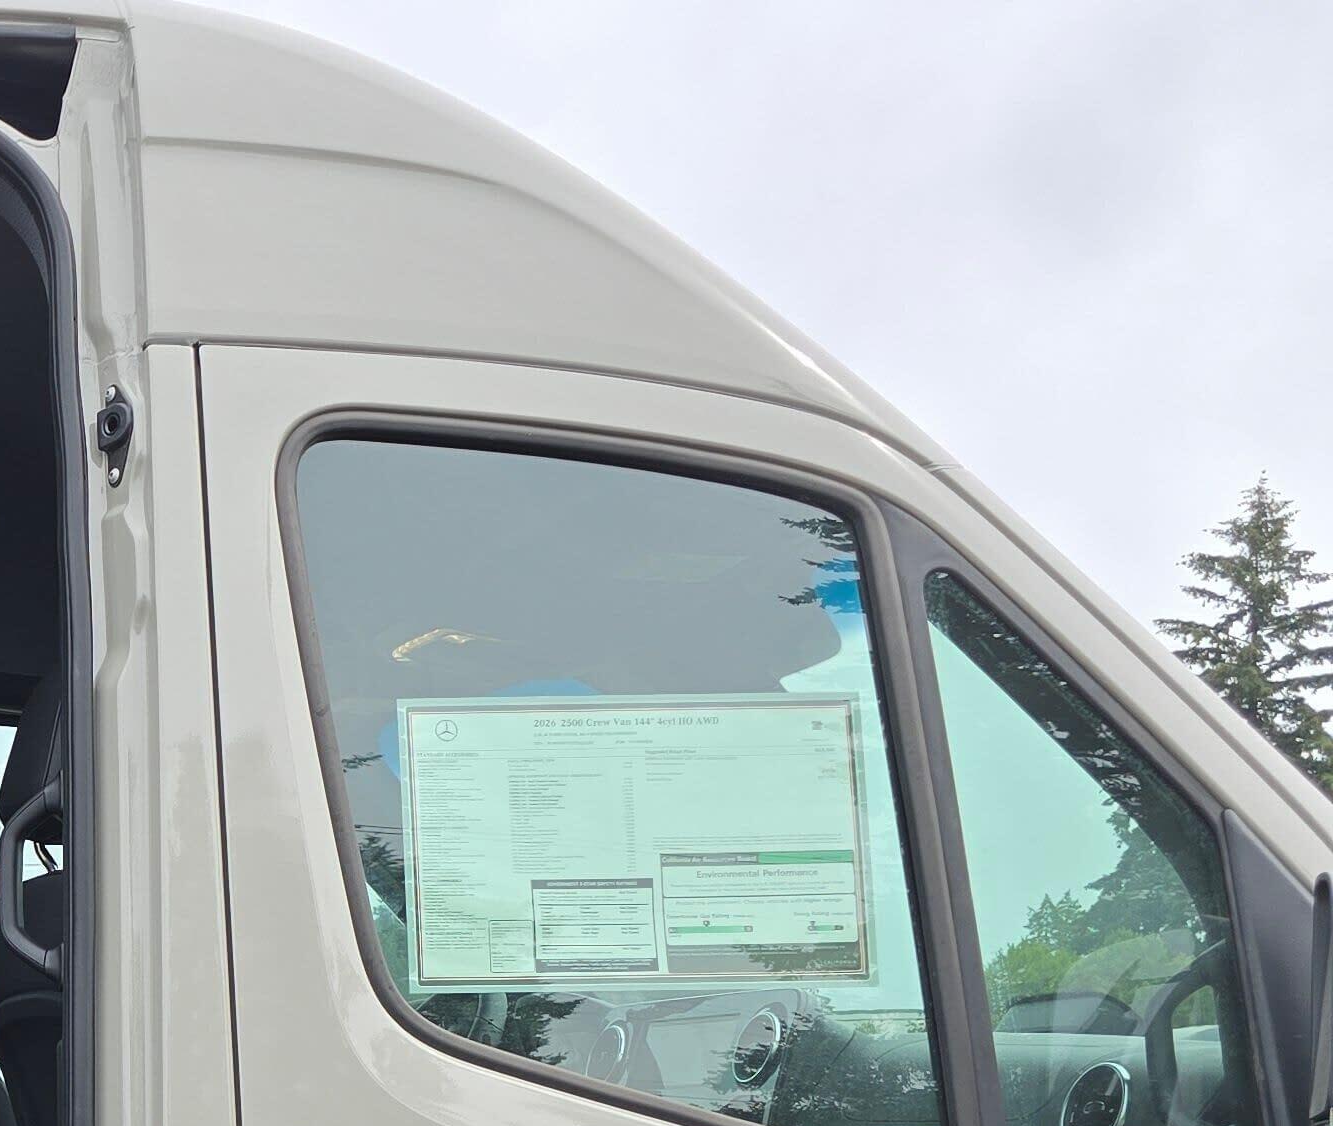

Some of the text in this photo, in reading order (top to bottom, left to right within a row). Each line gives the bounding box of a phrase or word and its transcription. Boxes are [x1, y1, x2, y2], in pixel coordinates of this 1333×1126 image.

[533, 719, 556, 728] 2026
[561, 718, 583, 727] 2500
[586, 718, 610, 727] Crew
[613, 718, 631, 726] Van
[657, 717, 676, 727] 4cyl
[696, 716, 719, 725] AWD
[696, 868, 818, 879] Environmental Performance
